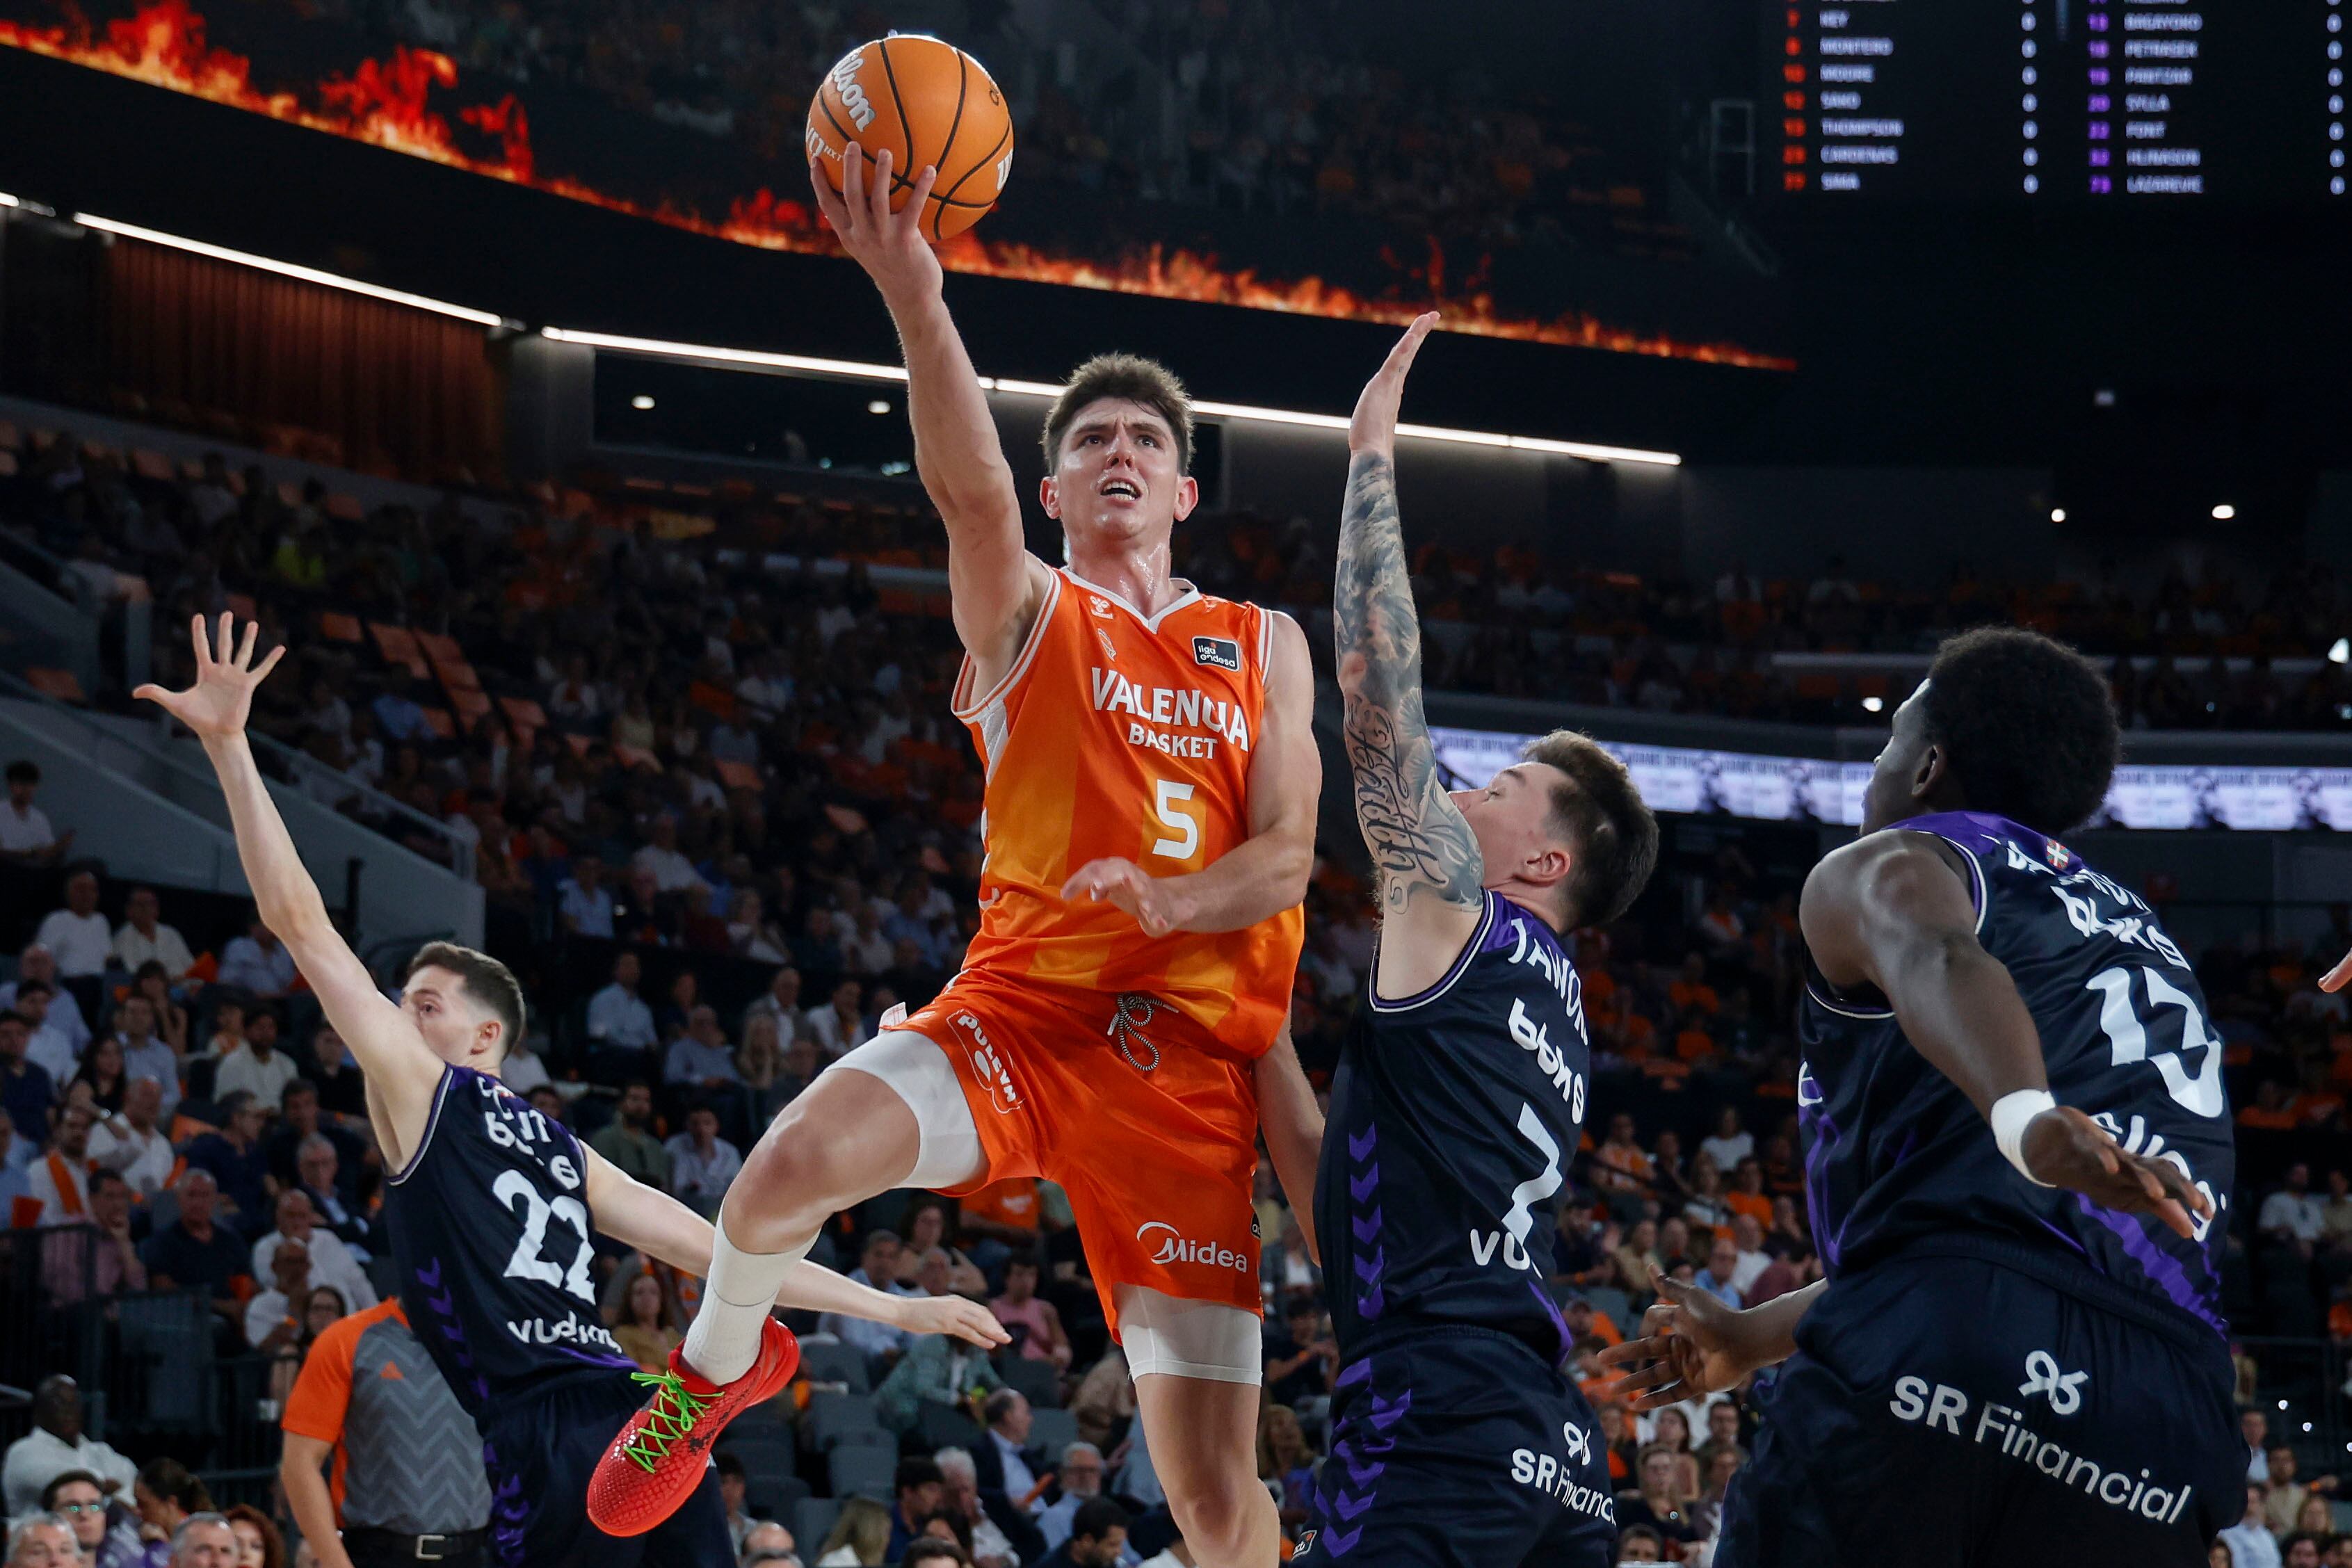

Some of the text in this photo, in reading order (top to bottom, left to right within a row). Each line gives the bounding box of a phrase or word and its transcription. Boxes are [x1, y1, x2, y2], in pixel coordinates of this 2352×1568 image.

[1198, 644, 1216, 654] liga
[1200, 653, 1236, 668] endesa
[1091, 666, 1249, 752] VALENCIA
[1128, 722, 1218, 760] BASKET
[1151, 778, 1199, 859] 5
[2086, 966, 2223, 1118] 13
[1500, 1101, 1563, 1247] 7
[492, 1168, 597, 1306] 22
[1150, 1236, 1248, 1273] Midea
[1511, 1448, 1558, 1494] SR
[1890, 1375, 2192, 1525] SR Financial
